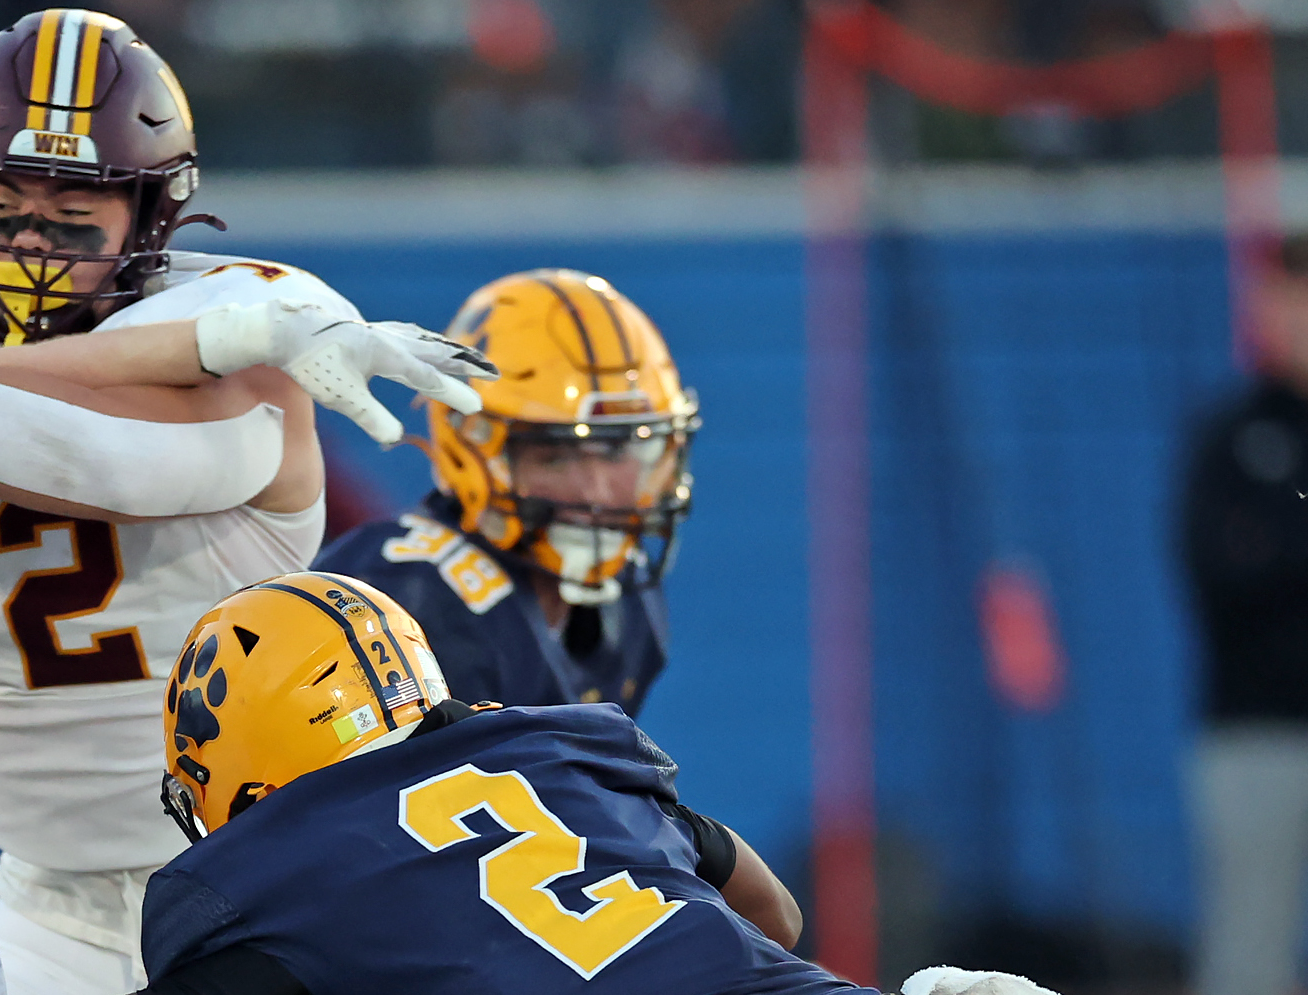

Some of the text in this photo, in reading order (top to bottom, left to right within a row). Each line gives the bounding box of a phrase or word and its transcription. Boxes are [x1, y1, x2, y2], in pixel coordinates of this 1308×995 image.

[371, 640, 391, 665] 2
[308, 705, 335, 725] Riddell
[397, 762, 688, 981] 2
